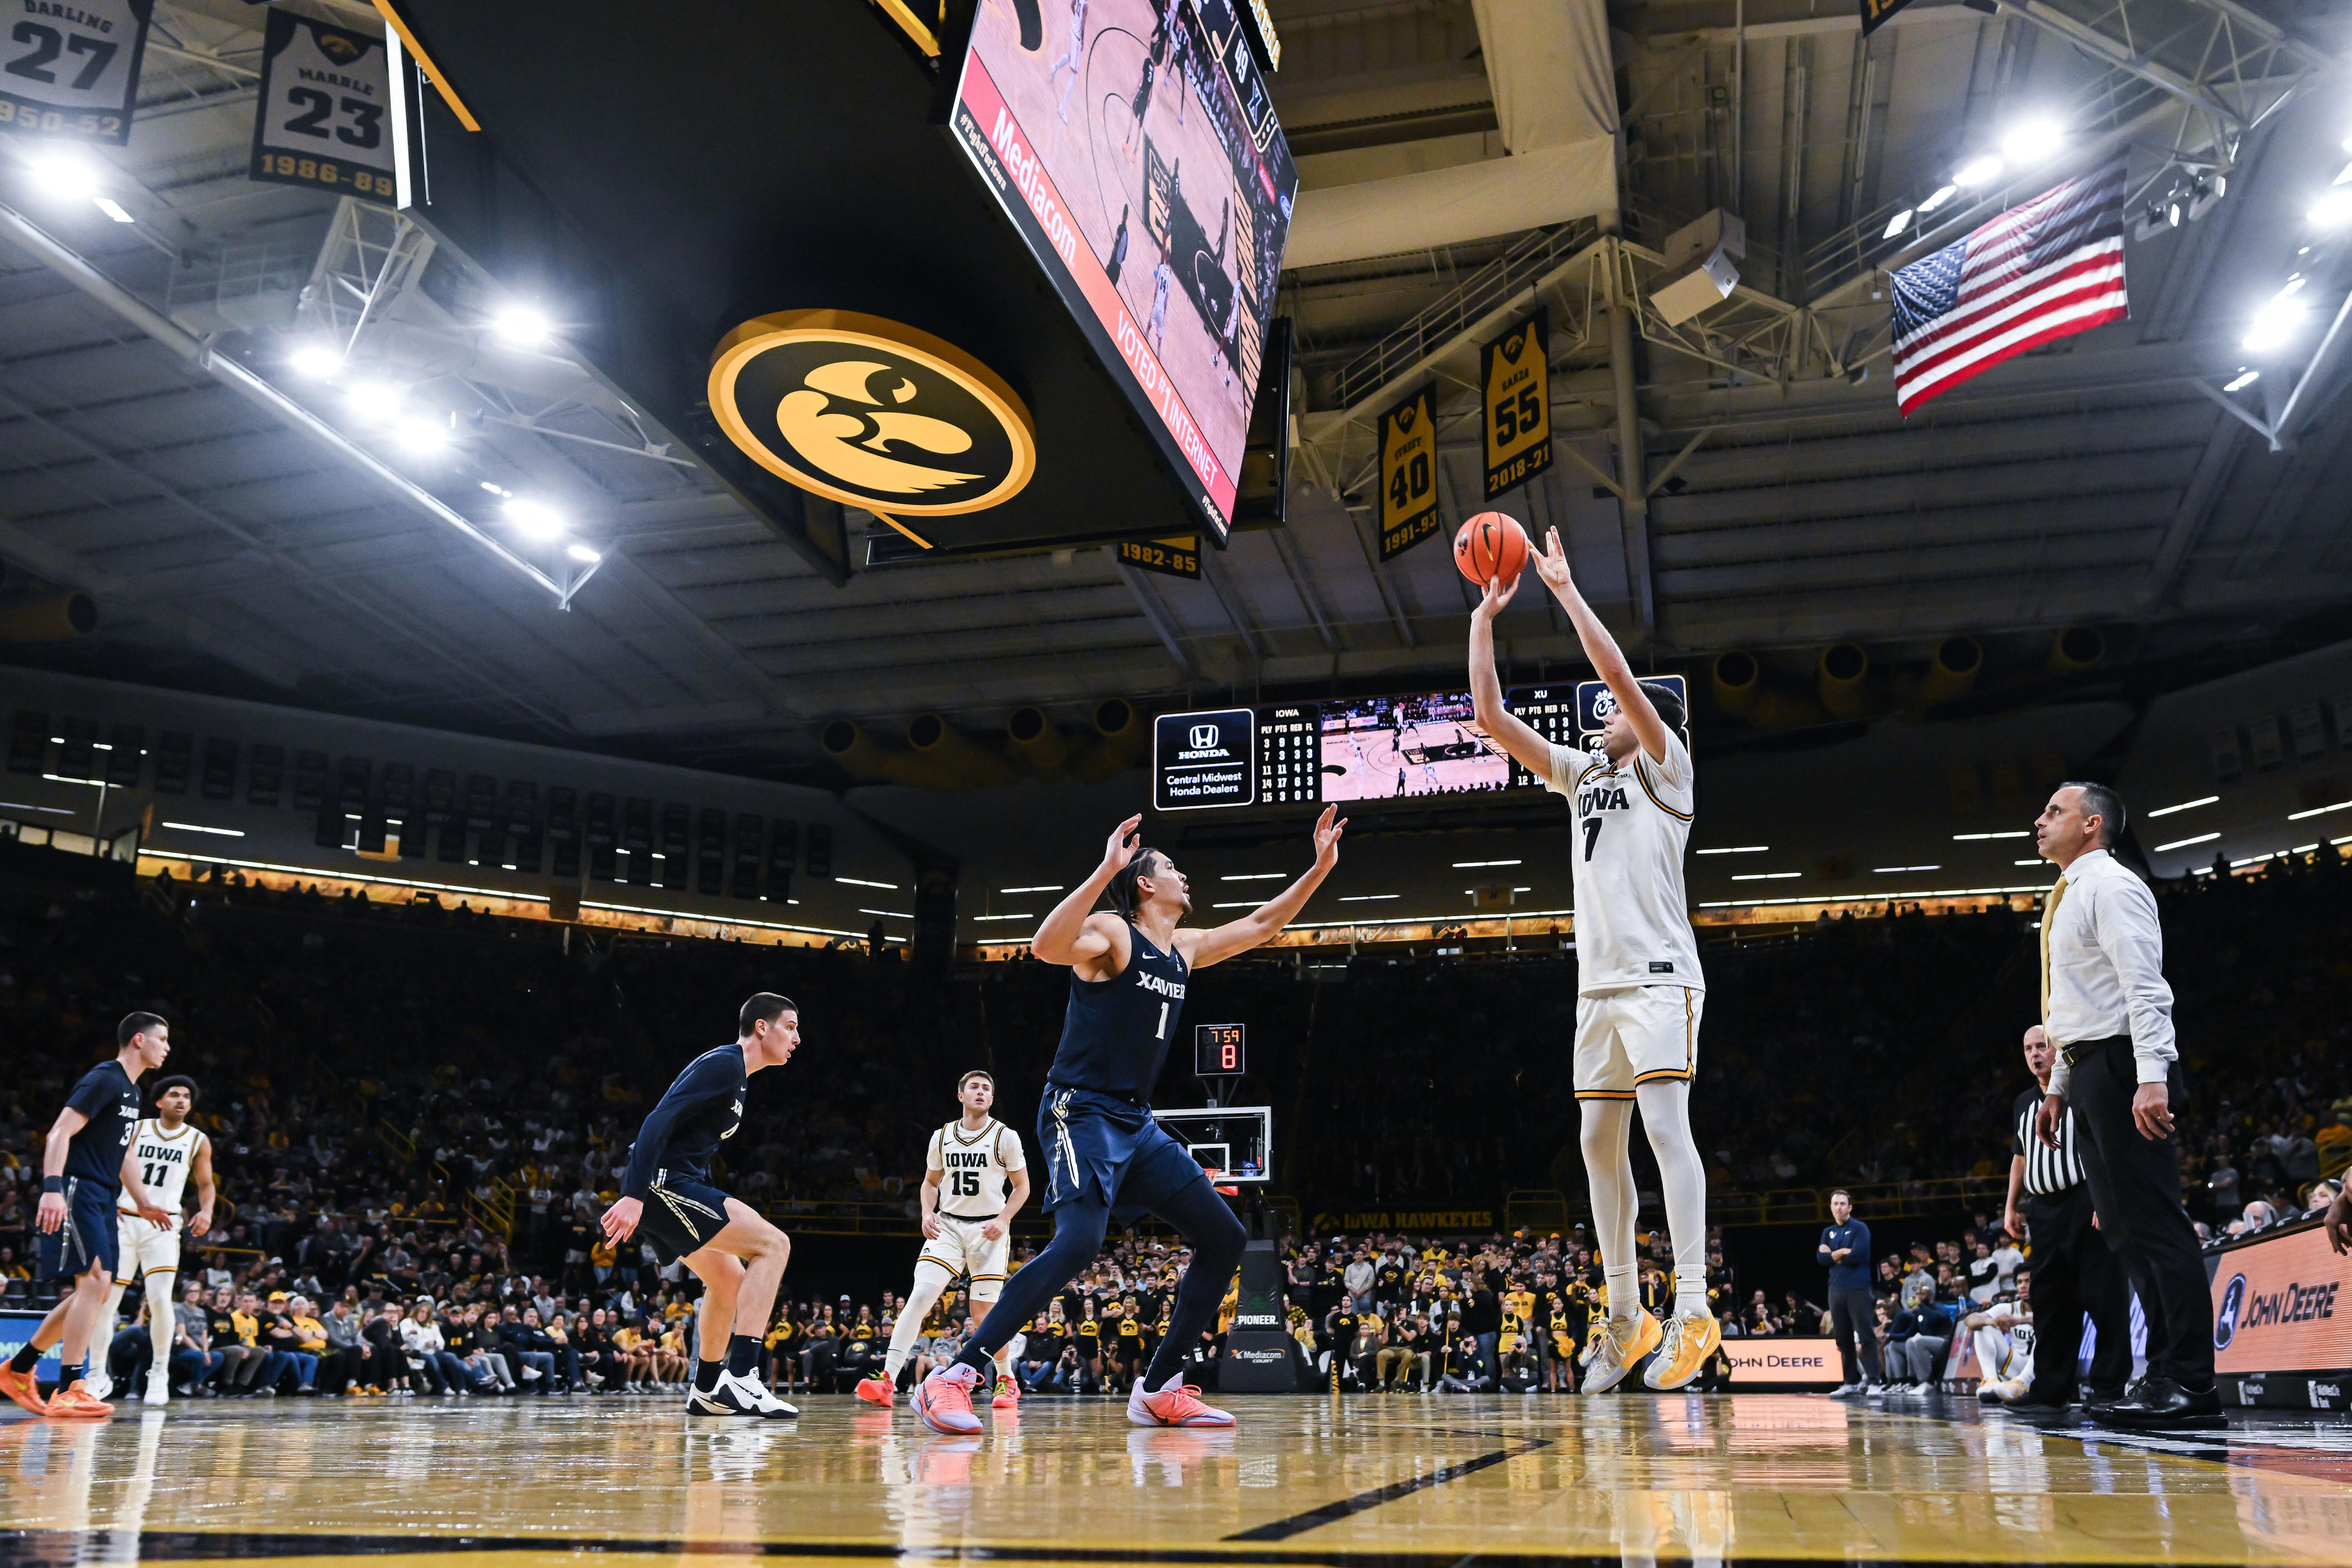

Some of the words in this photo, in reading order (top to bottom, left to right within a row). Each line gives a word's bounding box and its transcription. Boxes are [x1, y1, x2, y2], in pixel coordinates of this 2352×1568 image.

[24, 0, 114, 34] DARLING
[5, 21, 117, 91] 27
[298, 67, 376, 96] MARBLE
[0, 100, 122, 138] 950-52
[284, 86, 385, 149] 23
[262, 154, 393, 196] 1986-89
[992, 106, 1076, 266] Mediacom
[1117, 309, 1157, 390] VOTED
[1158, 375, 1170, 418] #1
[1169, 402, 1218, 488] INTERNET
[1495, 381, 1541, 447] 55
[1390, 451, 1429, 509] 40
[1489, 443, 1550, 493] 2018-21
[1385, 509, 1438, 553] 1991-93
[1122, 543, 1196, 572] 1982-85
[1534, 690, 1547, 699] XU
[1276, 709, 1299, 717] IOWA
[1514, 707, 1526, 716] PLY
[1529, 706, 1542, 715] PTS
[1545, 705, 1557, 714] REB
[1561, 704, 1569, 712] FL
[1261, 726, 1272, 734] PLY
[1275, 724, 1287, 733] PTS
[1290, 724, 1302, 732] REB
[1306, 722, 1313, 731] FL
[1533, 719, 1539, 729] 5
[1549, 717, 1556, 729] 0
[1562, 717, 1569, 728] 3
[1264, 738, 1270, 748] 3
[1279, 737, 1285, 748] 9
[1306, 735, 1312, 745] 0
[1550, 731, 1556, 742] 2
[1563, 730, 1569, 741] 2
[1178, 749, 1230, 759] HONDA
[1264, 751, 1270, 761] 7
[1279, 750, 1285, 761] 3
[1294, 749, 1301, 759] 3
[1306, 748, 1313, 759] 3
[1166, 773, 1200, 785] Central
[1202, 772, 1242, 783] Midwest
[1262, 765, 1272, 776] 11
[1277, 764, 1287, 774] 11
[1294, 763, 1301, 773] 4
[1307, 762, 1313, 773] 2
[1518, 776, 1528, 786] 12
[1170, 785, 1201, 797] Honda
[1203, 784, 1239, 795] Dealers
[1262, 779, 1272, 789] 14
[1277, 777, 1287, 788] 17
[1294, 777, 1301, 787] 6
[1307, 776, 1313, 786] 3
[1262, 792, 1272, 802] 15
[1279, 791, 1286, 801] 3
[1294, 790, 1301, 801] 0
[1307, 789, 1314, 800] 0
[1578, 787, 1630, 819] IOWA
[1582, 818, 1602, 862] 7
[1136, 971, 1186, 999] XAVIER
[1155, 1002, 1169, 1040] 1
[1222, 1045, 1236, 1069] 8
[138, 1145, 182, 1163] IOWA
[946, 1153, 988, 1167] IOWA
[143, 1163, 168, 1187] 11
[952, 1171, 979, 1196] 15
[1344, 1212, 1390, 1229] IOWA
[1395, 1211, 1493, 1228] HAWKEYES
[2241, 1290, 2284, 1329] JOHN
[2281, 1281, 2340, 1323] DEERE
[1244, 1350, 1282, 1359] Mediacom
[1728, 1358, 1762, 1368] OHN
[1768, 1356, 1824, 1367] DEERE
